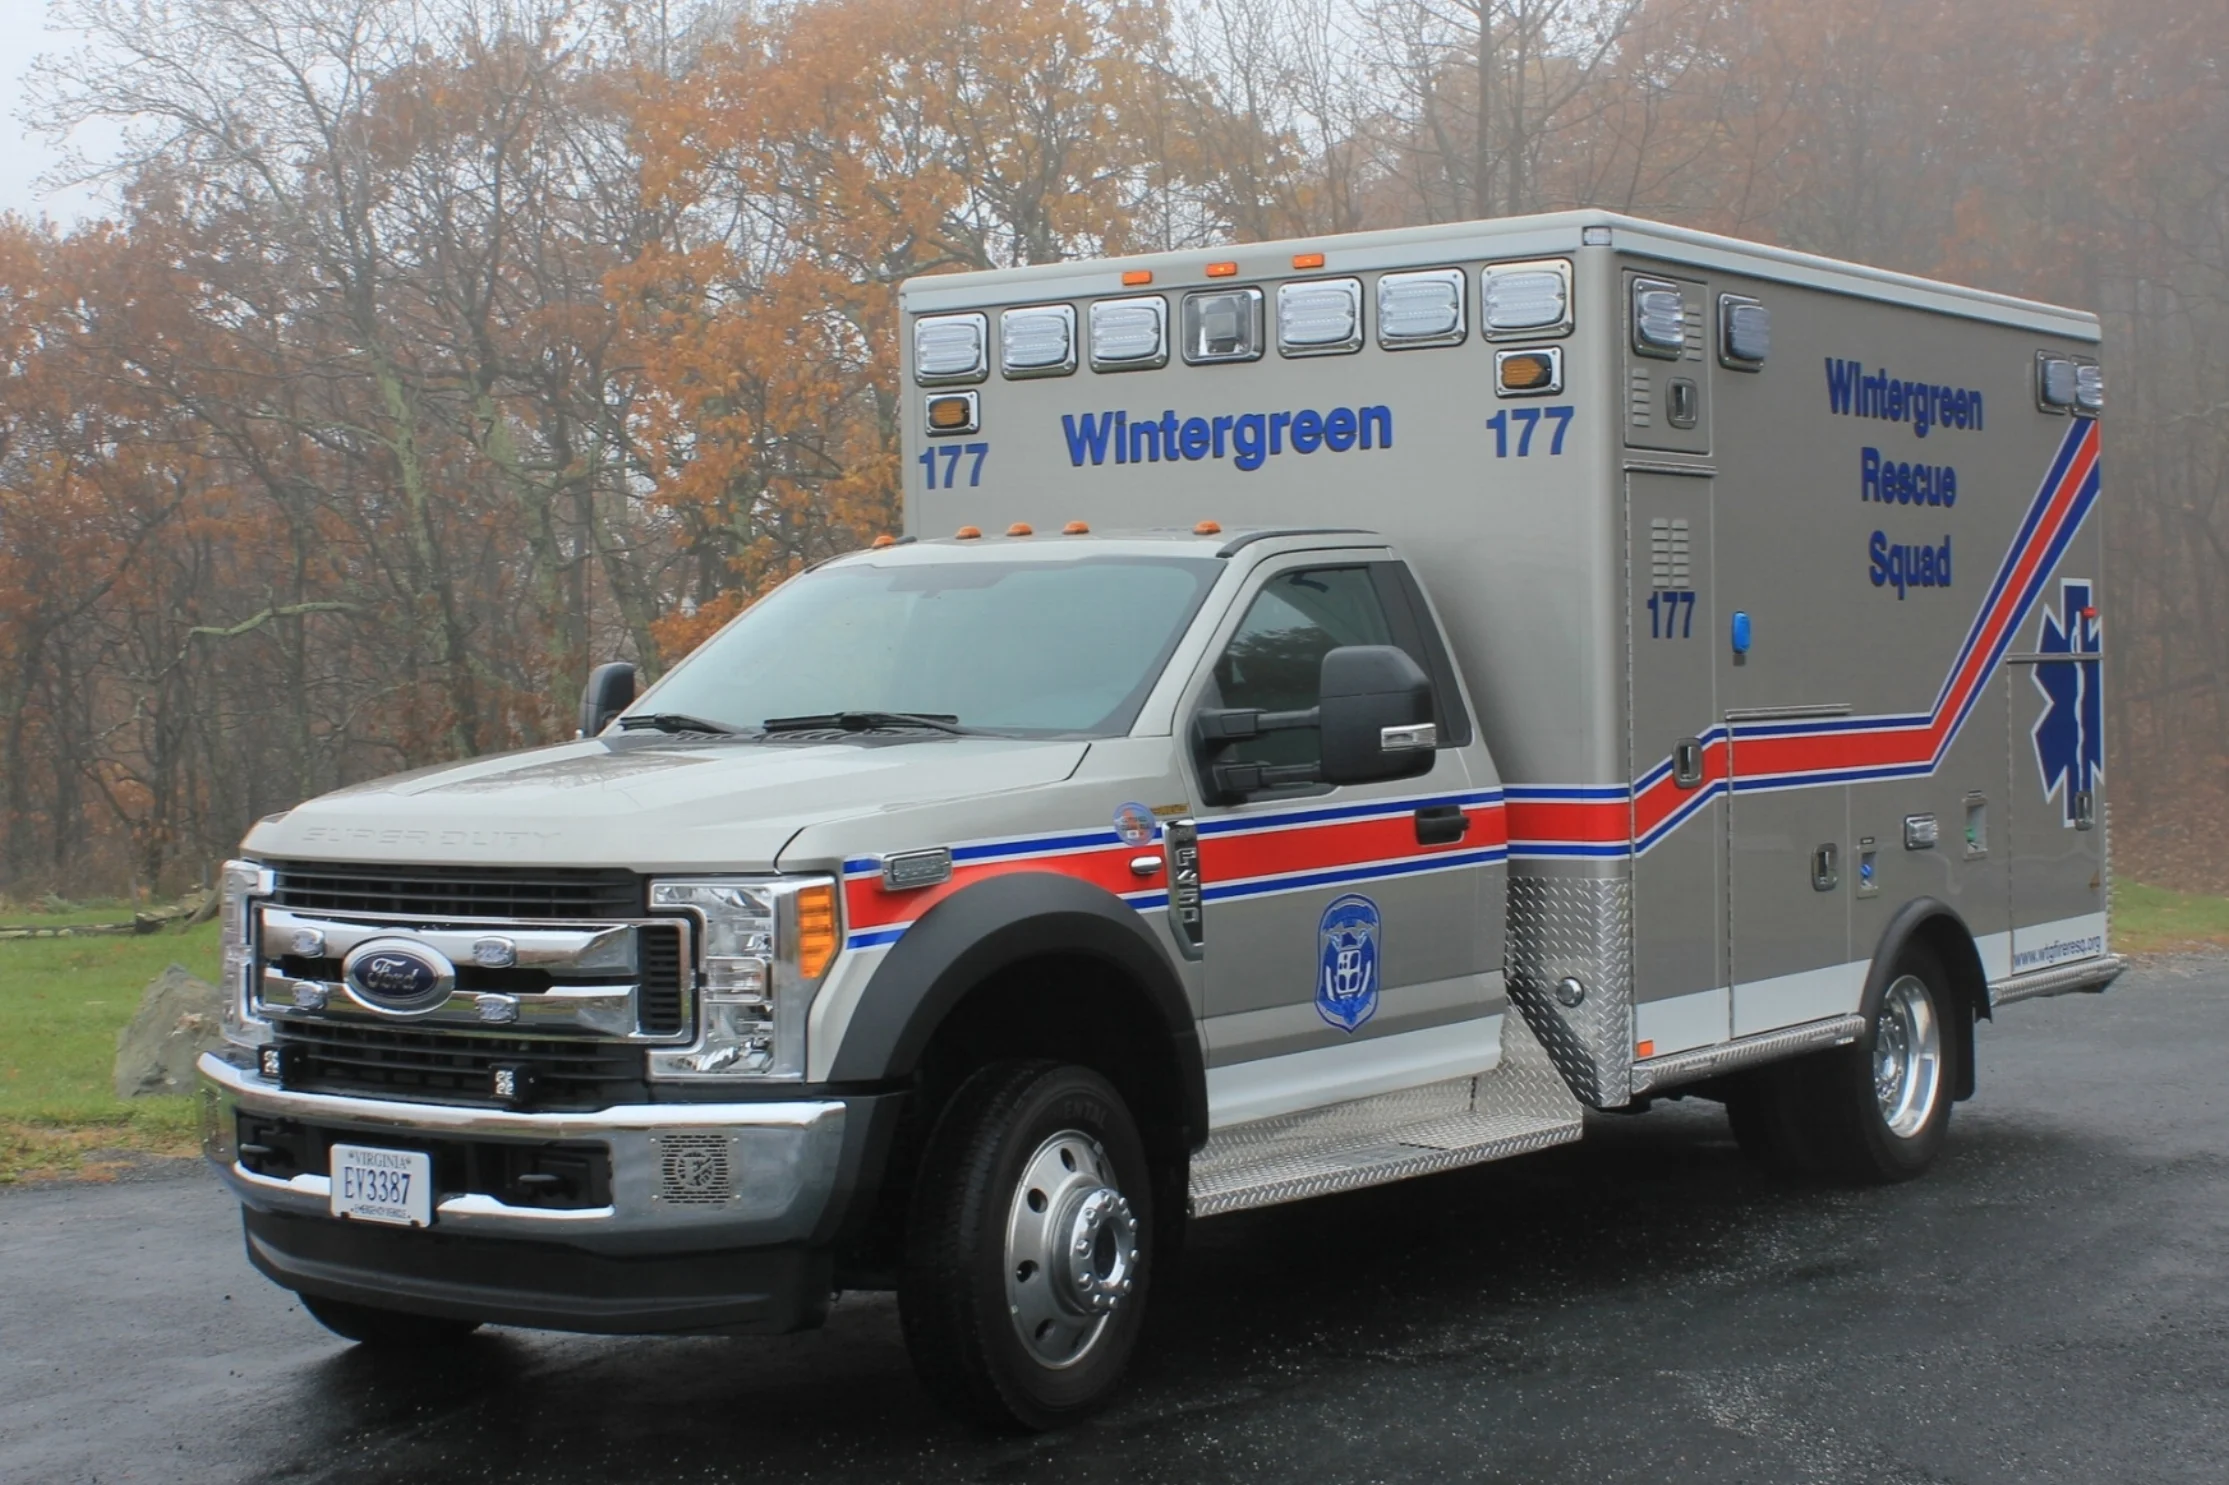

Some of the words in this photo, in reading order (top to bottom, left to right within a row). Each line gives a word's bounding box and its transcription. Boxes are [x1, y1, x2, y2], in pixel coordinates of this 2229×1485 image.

[1825, 357, 1984, 439] Wintergreen
[1061, 404, 1393, 471] Wintergreen
[1485, 405, 1575, 458] 177
[918, 442, 989, 490] 177
[1861, 447, 1957, 508] Rescue
[1869, 530, 1952, 601] Squad
[1647, 591, 1696, 639] 177
[301, 826, 429, 845] SUPER
[440, 828, 562, 847] DUTY
[367, 957, 420, 990] Ford
[354, 1152, 408, 1169] VIRGINIA
[345, 1166, 412, 1205] EV3387
